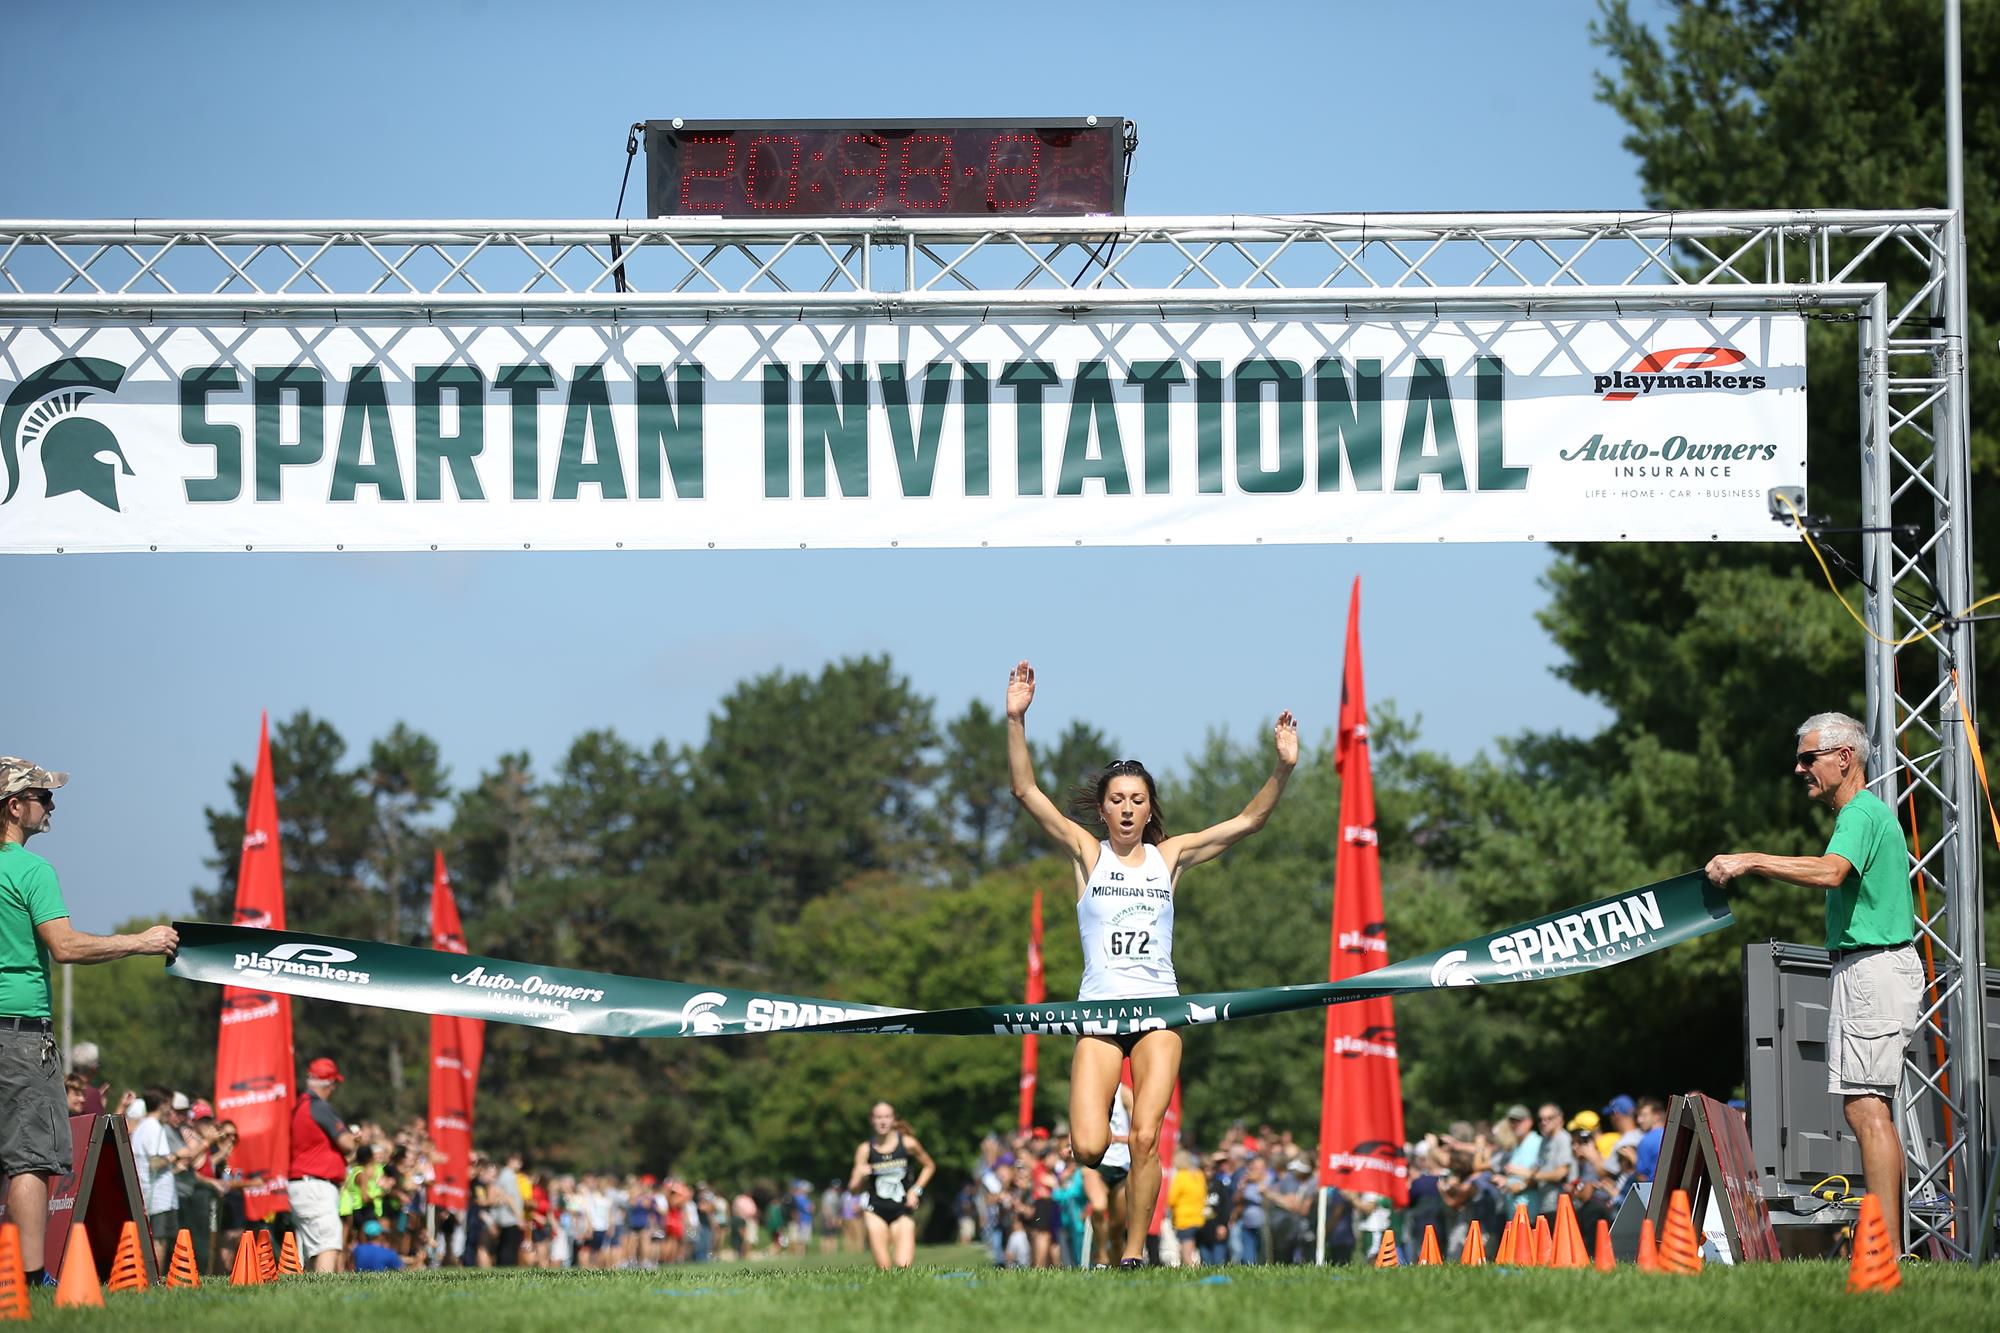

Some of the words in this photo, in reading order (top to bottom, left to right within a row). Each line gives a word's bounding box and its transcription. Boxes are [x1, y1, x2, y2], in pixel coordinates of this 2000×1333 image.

[1593, 371, 1766, 393] playmakers
[179, 363, 706, 504] SPARTAN
[761, 356, 1532, 500] INVITATIONAL
[1559, 434, 1778, 461] Auto-Owners
[1614, 466, 1731, 478] INSURANCE
[1585, 489, 1607, 498] LIFE
[1621, 489, 1655, 498] HOME
[1669, 489, 1692, 498] CAR
[1706, 489, 1761, 498] BUSINESS
[1092, 886, 1145, 898] MICHIGAN
[1146, 888, 1171, 902] STATE
[1111, 931, 1150, 956] 672
[1488, 891, 1665, 976] SPARTAN
[233, 952, 370, 984] playmakers
[1512, 934, 1657, 982] INVITATIONAL
[451, 966, 605, 1003] Auto-Owners
[1003, 1005, 1153, 1023] INVITATIONAL
